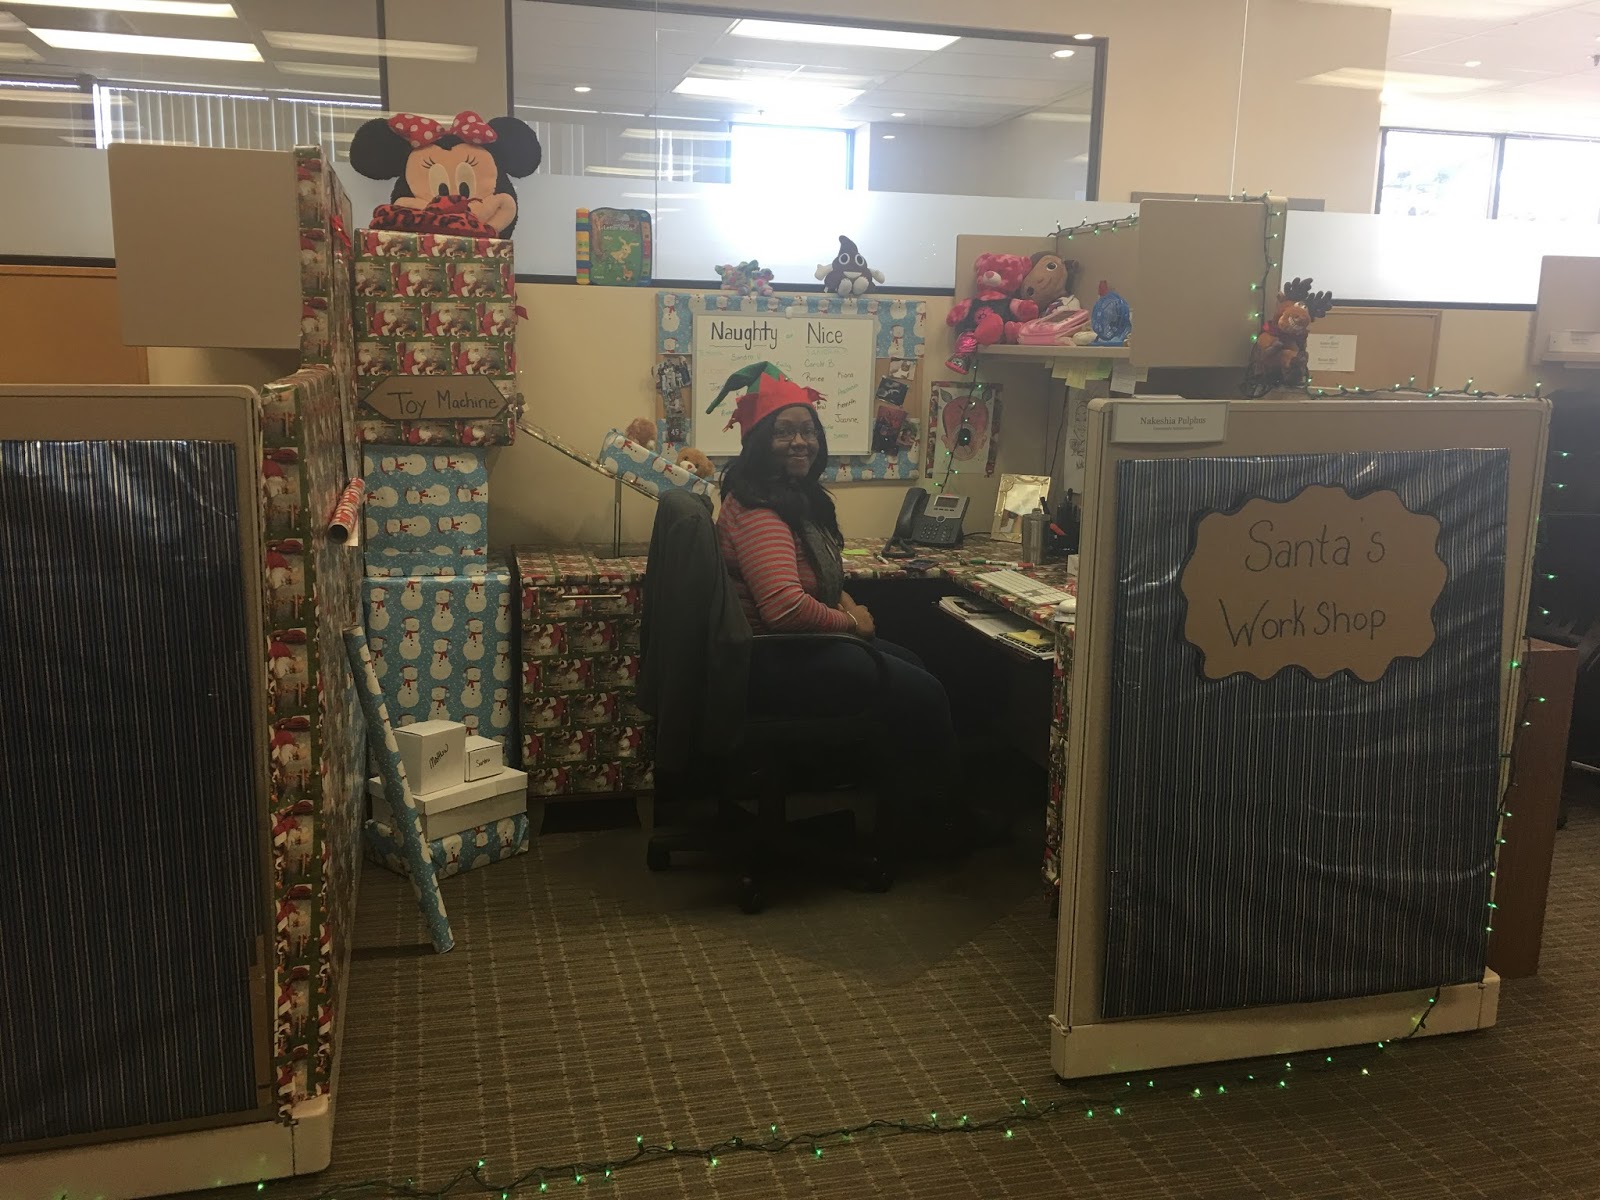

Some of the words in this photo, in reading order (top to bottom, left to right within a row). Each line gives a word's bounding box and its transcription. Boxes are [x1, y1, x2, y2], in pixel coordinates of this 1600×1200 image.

[711, 320, 778, 350] Naughty
[807, 322, 843, 345] Nice
[387, 391, 427, 419] Toy
[437, 390, 499, 410] Machine
[834, 414, 859, 424] Joanne
[1140, 416, 1176, 425] Nakeshia
[1245, 516, 1386, 573] Santa's
